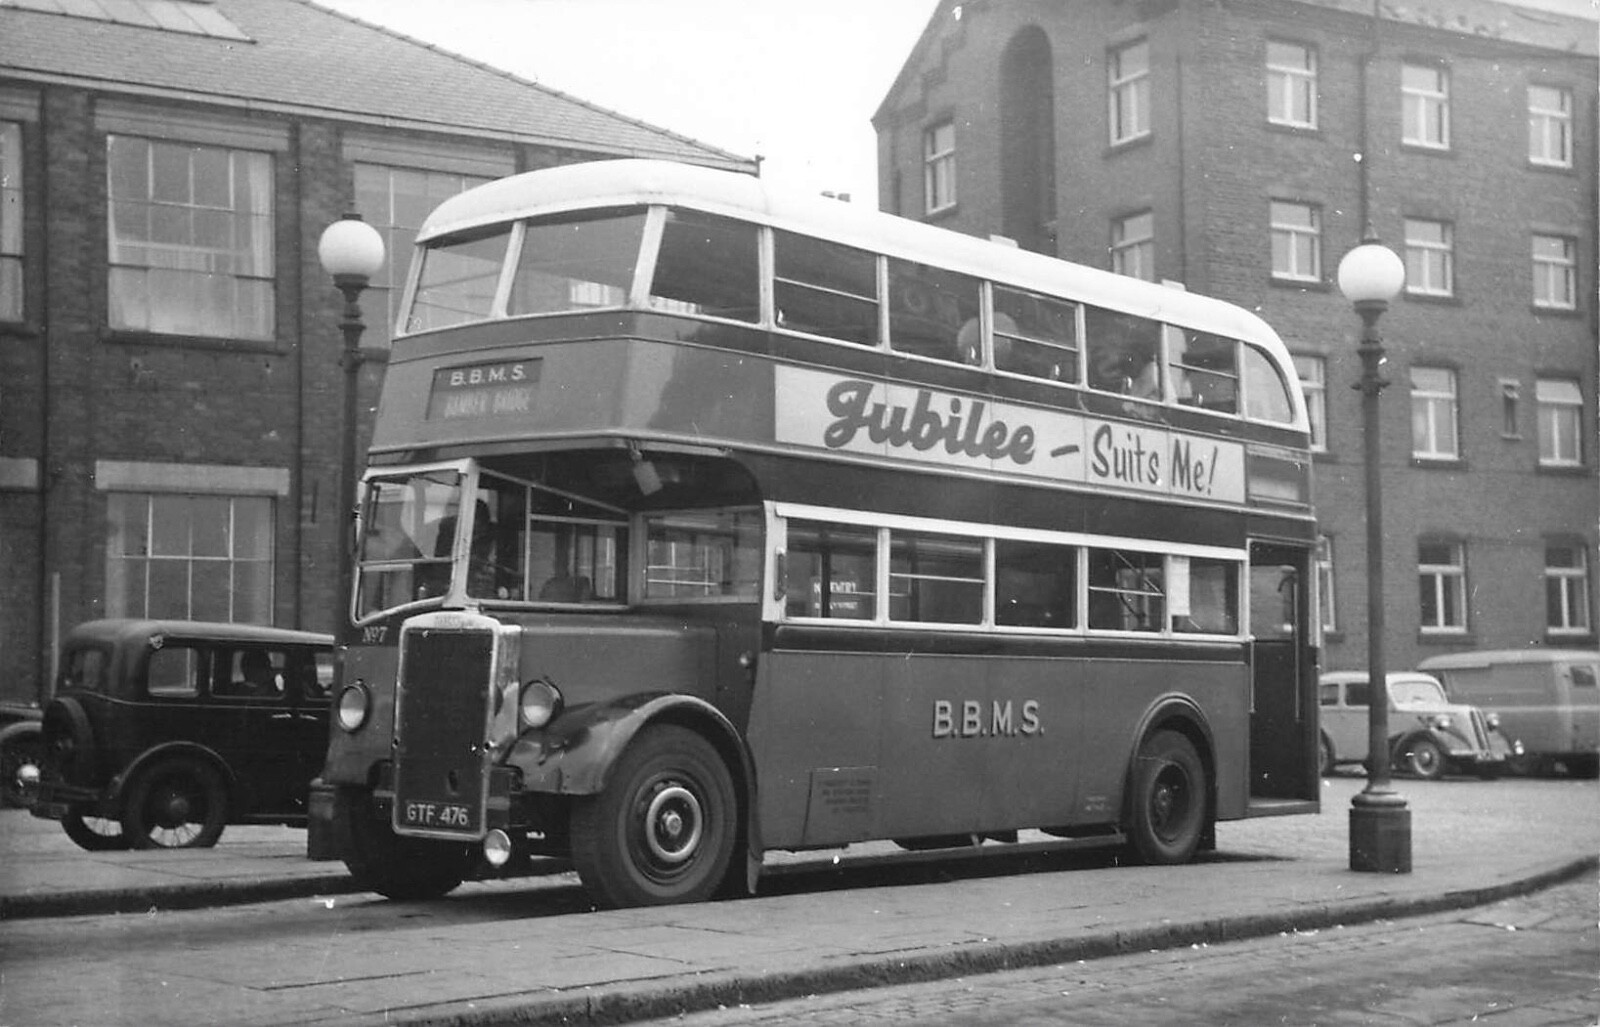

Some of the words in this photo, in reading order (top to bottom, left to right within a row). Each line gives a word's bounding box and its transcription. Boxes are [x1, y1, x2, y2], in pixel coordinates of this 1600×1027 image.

[450, 364, 527, 386] B.B.M.S.
[824, 380, 1035, 465] Jubilee
[1091, 424, 1160, 485] Suits
[1171, 438, 1218, 495] Me!
[933, 700, 1045, 737] B.B.M.S.
[407, 804, 435, 823] GTF
[440, 806, 468, 826] 476
